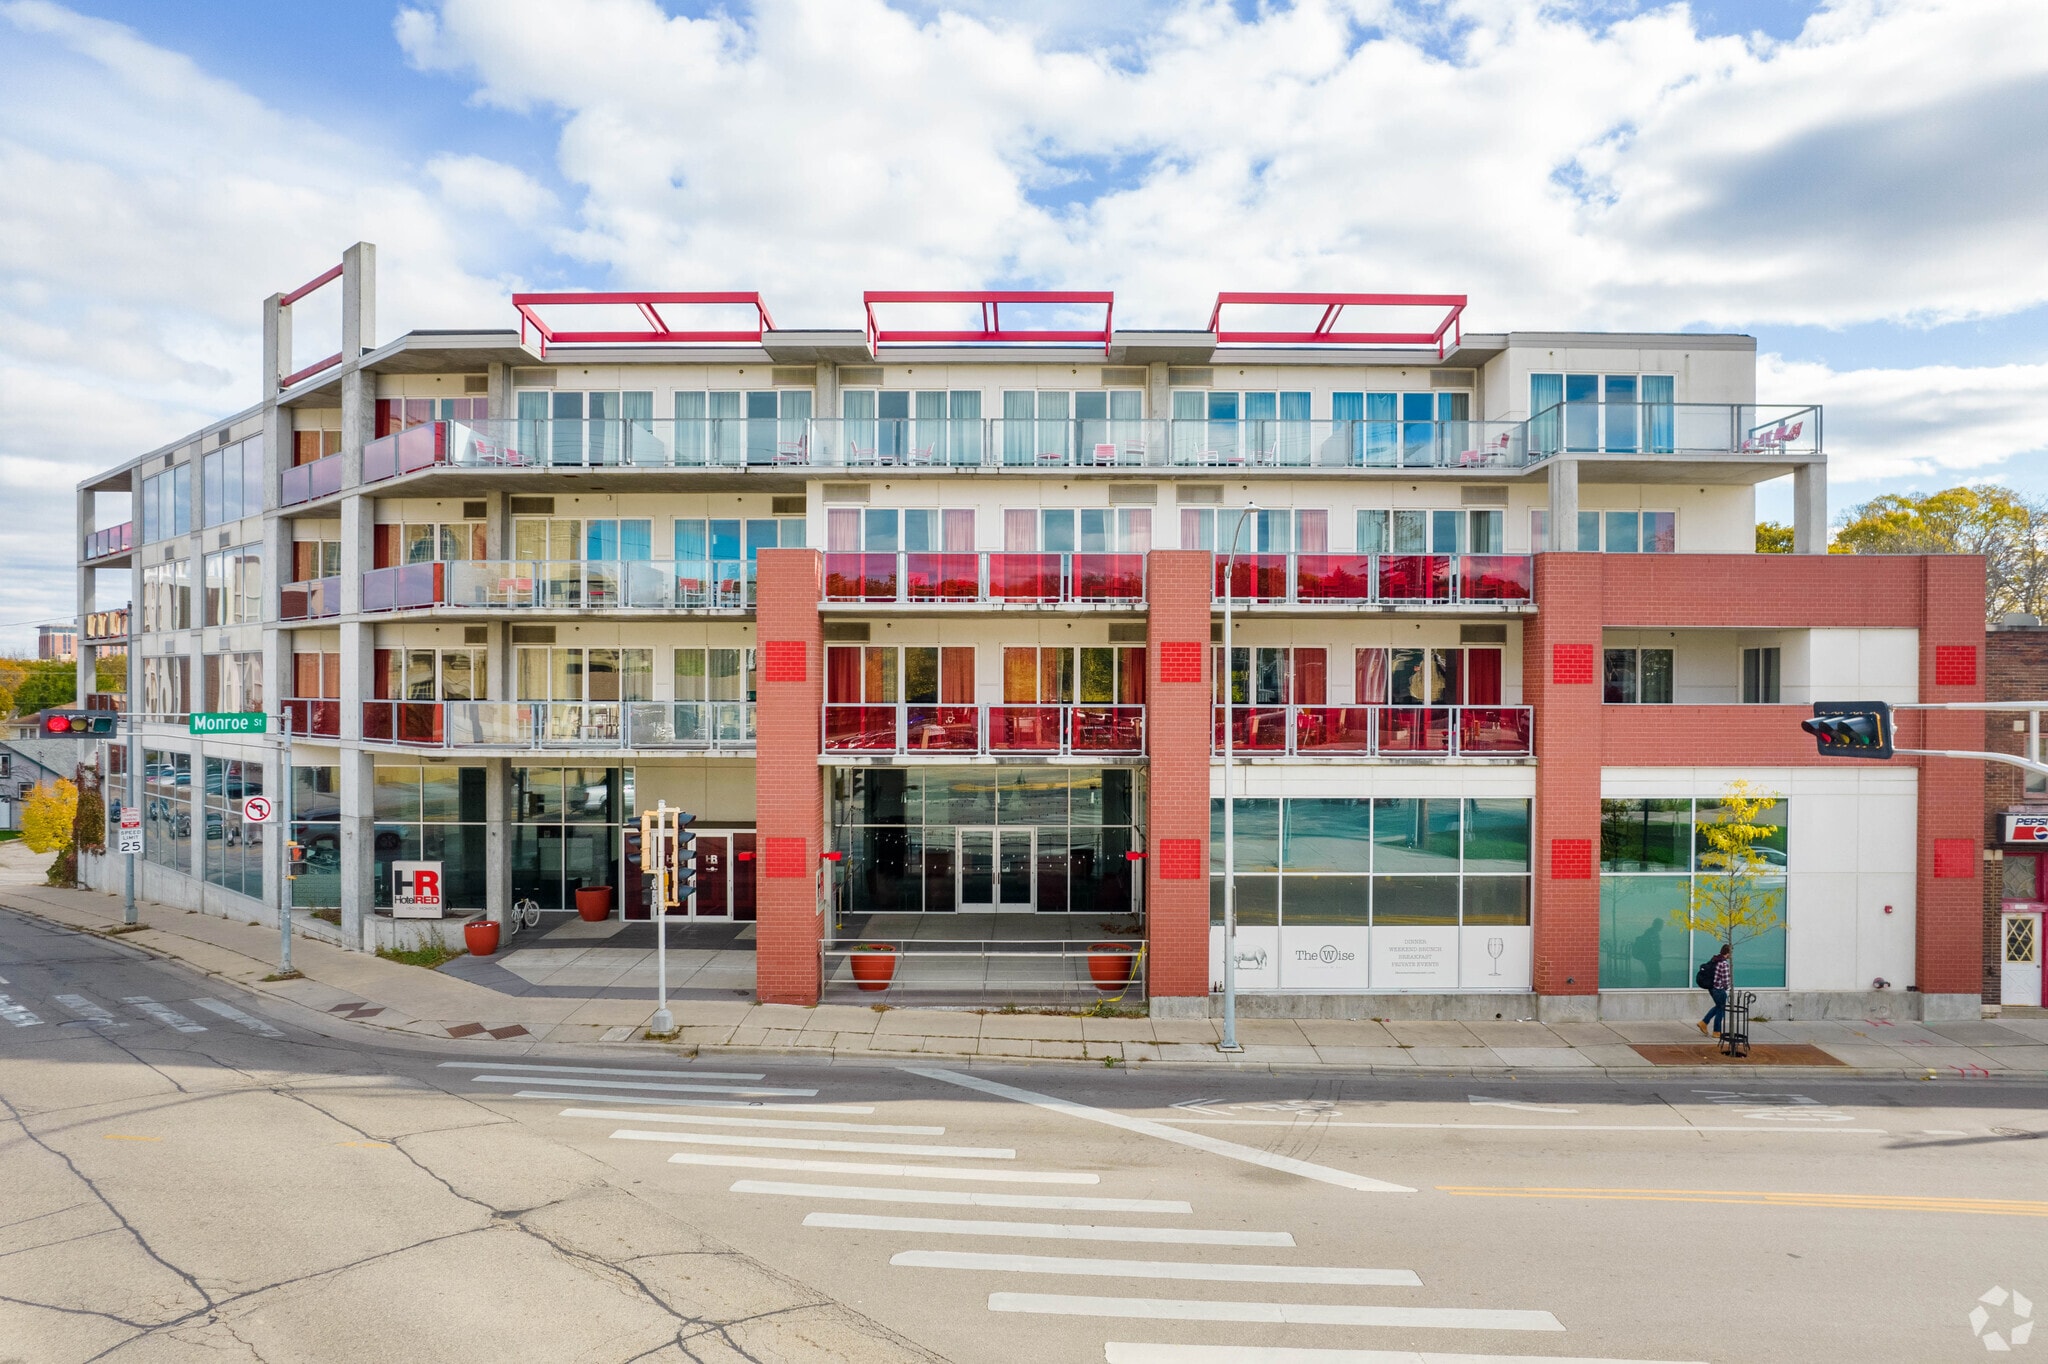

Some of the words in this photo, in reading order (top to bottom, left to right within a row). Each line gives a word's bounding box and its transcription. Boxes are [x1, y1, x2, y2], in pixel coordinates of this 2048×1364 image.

[194, 715, 248, 730] Monroe
[253, 718, 262, 727] St
[121, 841, 141, 852] 25
[394, 870, 439, 896] HR
[1295, 950, 1318, 961] The
[1321, 948, 1355, 962] Wise
